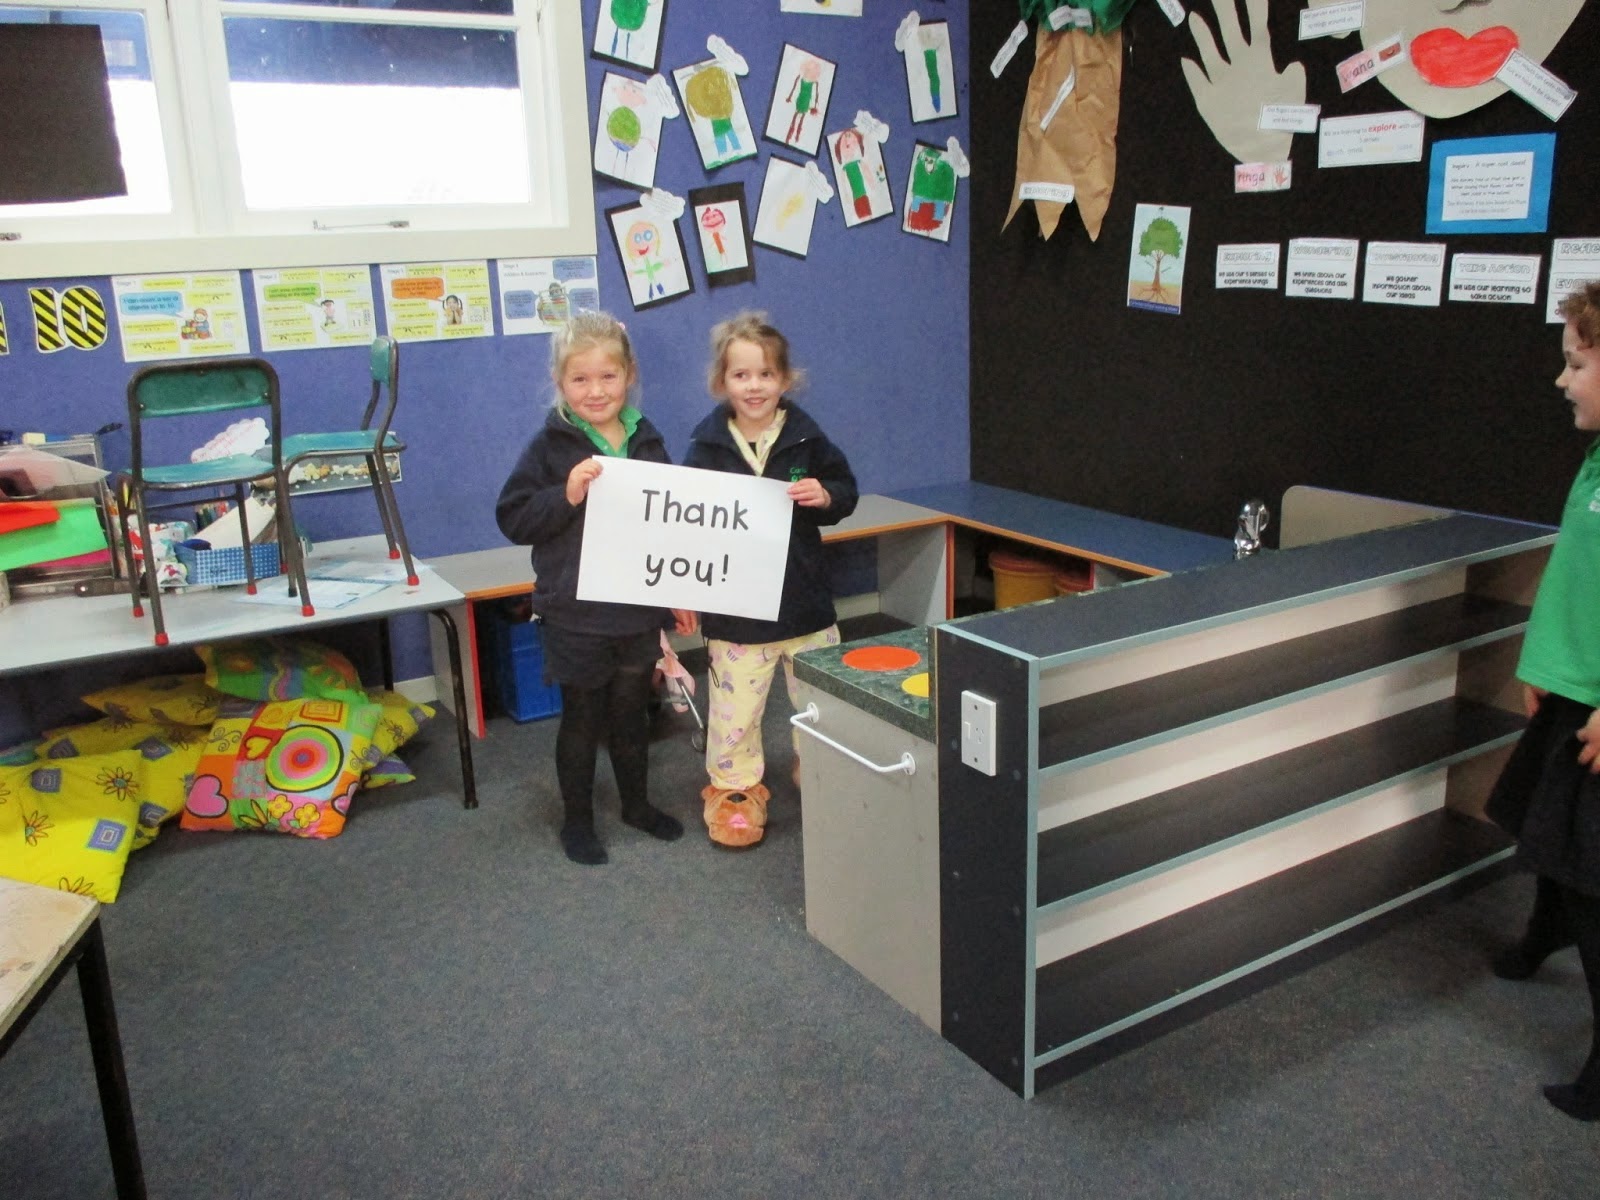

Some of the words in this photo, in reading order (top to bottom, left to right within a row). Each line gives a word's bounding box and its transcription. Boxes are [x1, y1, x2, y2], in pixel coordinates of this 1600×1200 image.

[1368, 123, 1397, 133] explore
[1238, 172, 1265, 186] ringa
[1459, 263, 1486, 272] Take
[1488, 263, 1530, 274] Action
[1491, 285, 1520, 294] learning
[642, 489, 749, 530] Thank
[645, 554, 729, 587] you!
